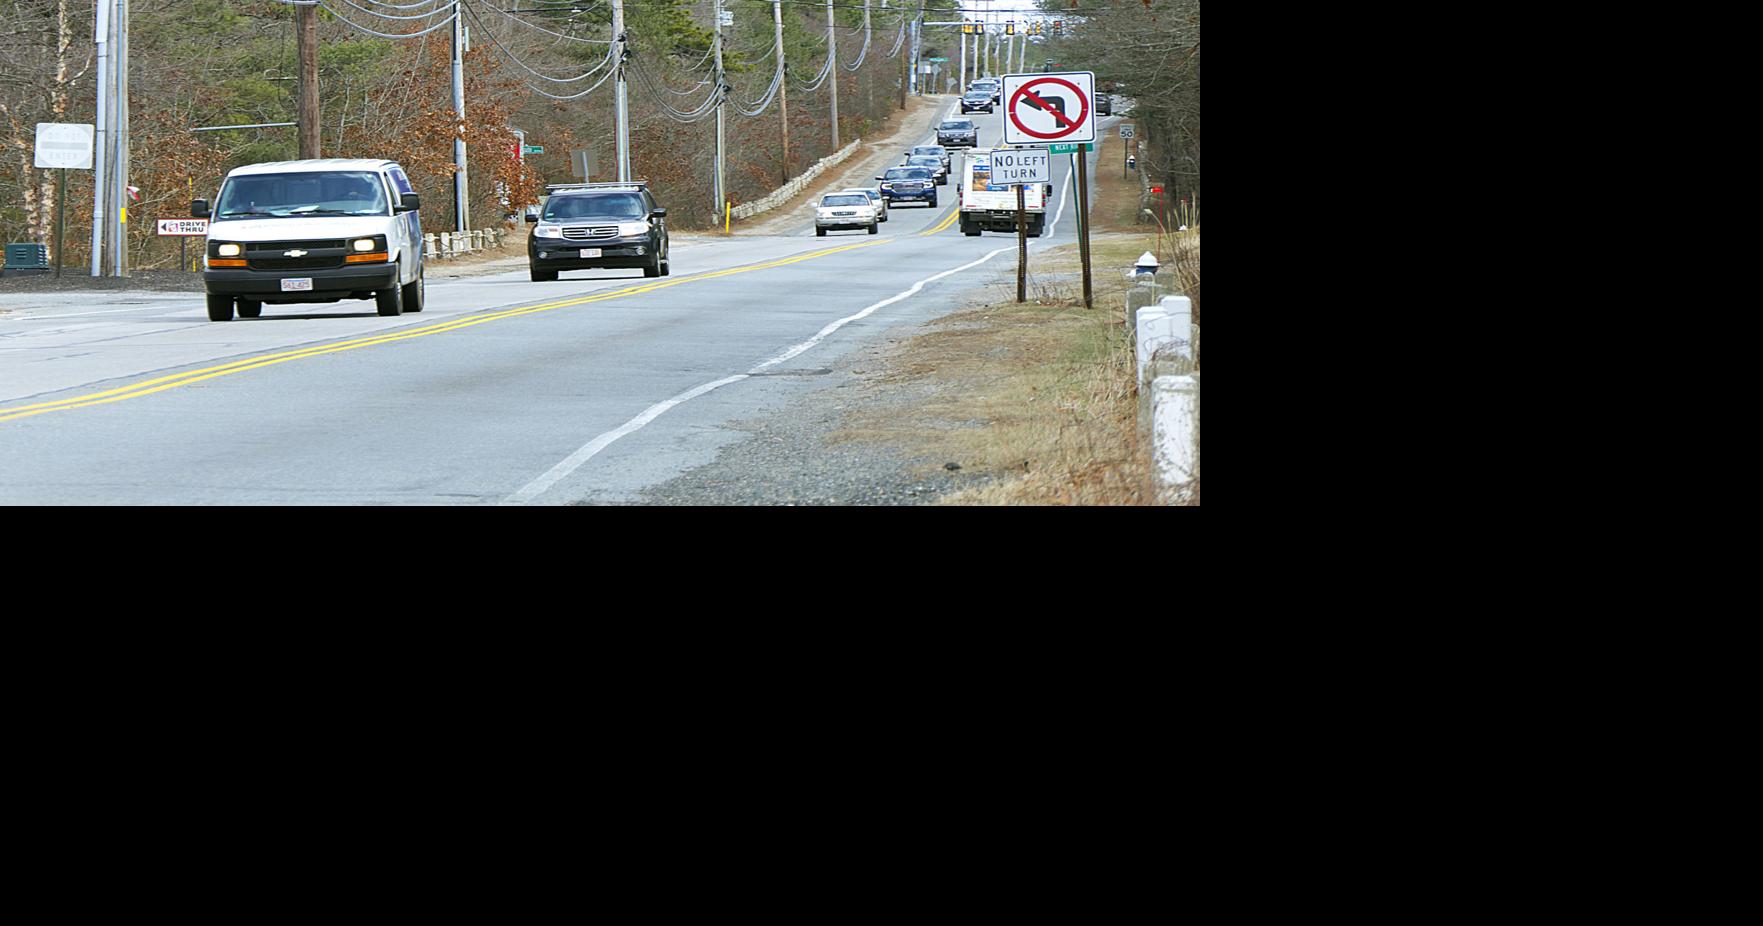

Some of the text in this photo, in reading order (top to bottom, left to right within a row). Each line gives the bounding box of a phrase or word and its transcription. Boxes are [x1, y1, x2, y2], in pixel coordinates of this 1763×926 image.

[996, 156, 1046, 167] NO LEFT
[1004, 169, 1037, 178] TURN
